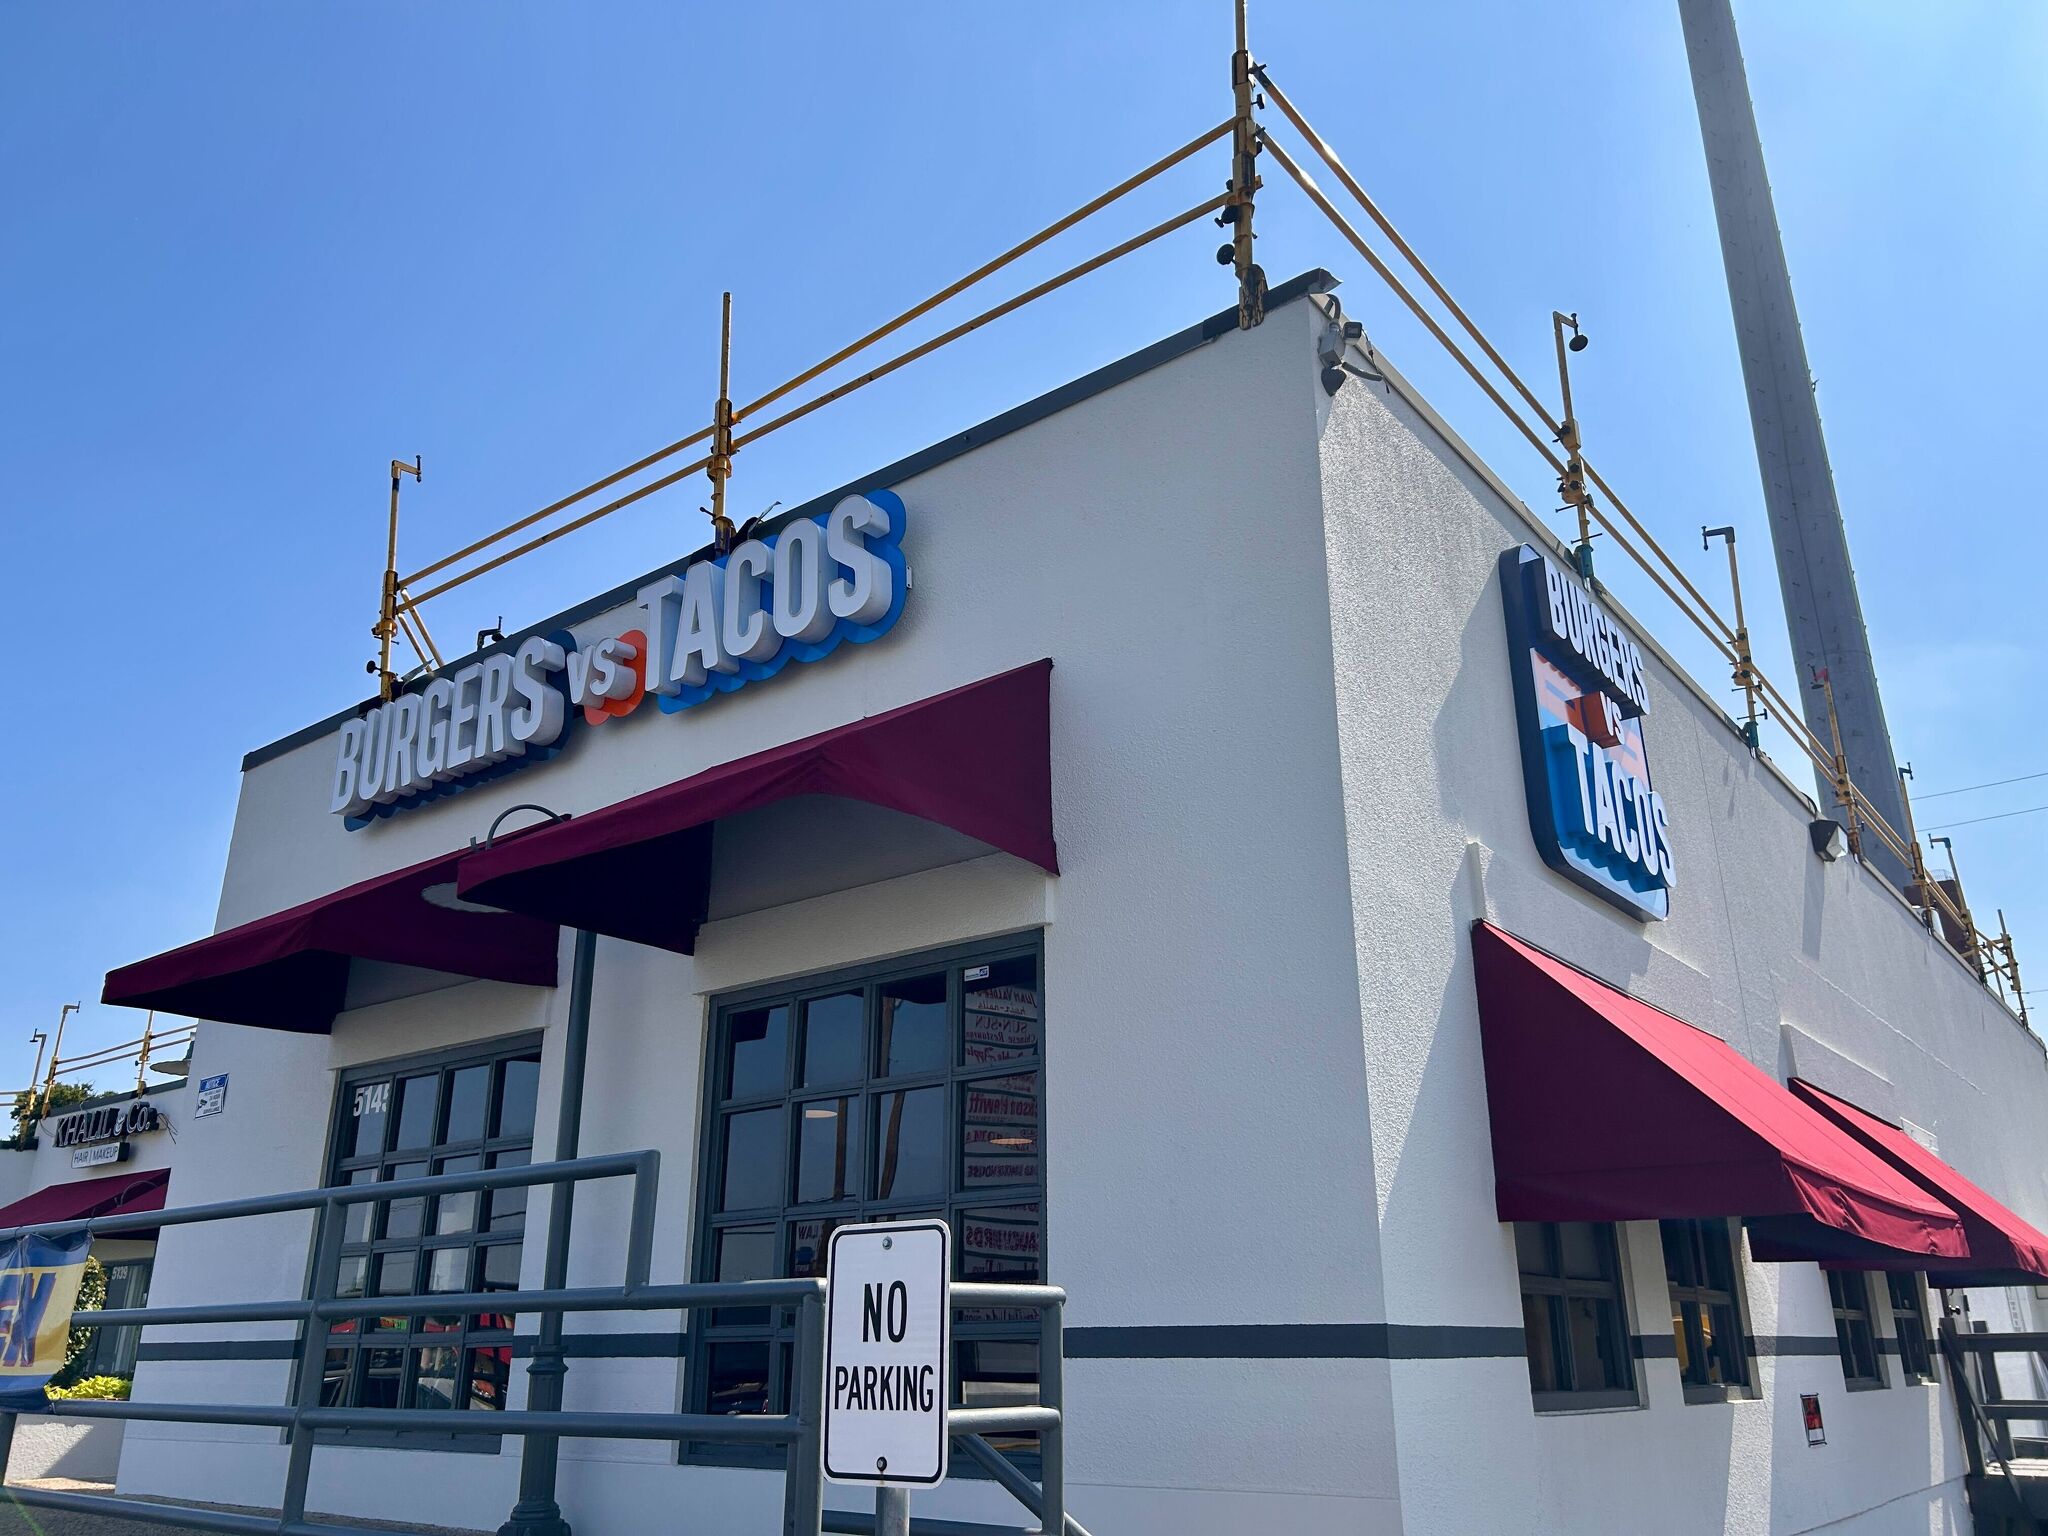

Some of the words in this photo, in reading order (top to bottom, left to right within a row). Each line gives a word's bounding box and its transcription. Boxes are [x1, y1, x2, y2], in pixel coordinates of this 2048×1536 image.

[330, 635, 566, 816] BURGERS
[636, 493, 893, 698] TACOS
[1544, 556, 1650, 716] BURGERS
[1567, 723, 1677, 888] TACOS
[55, 1107, 113, 1147] KHALIL
[113, 1110, 125, 1136] &
[73, 1151, 89, 1165] HAIR
[93, 1145, 119, 1160] MAKEUP
[111, 1265, 129, 1280] 5139
[862, 1280, 908, 1343] NO
[834, 1364, 934, 1413] PARKING
